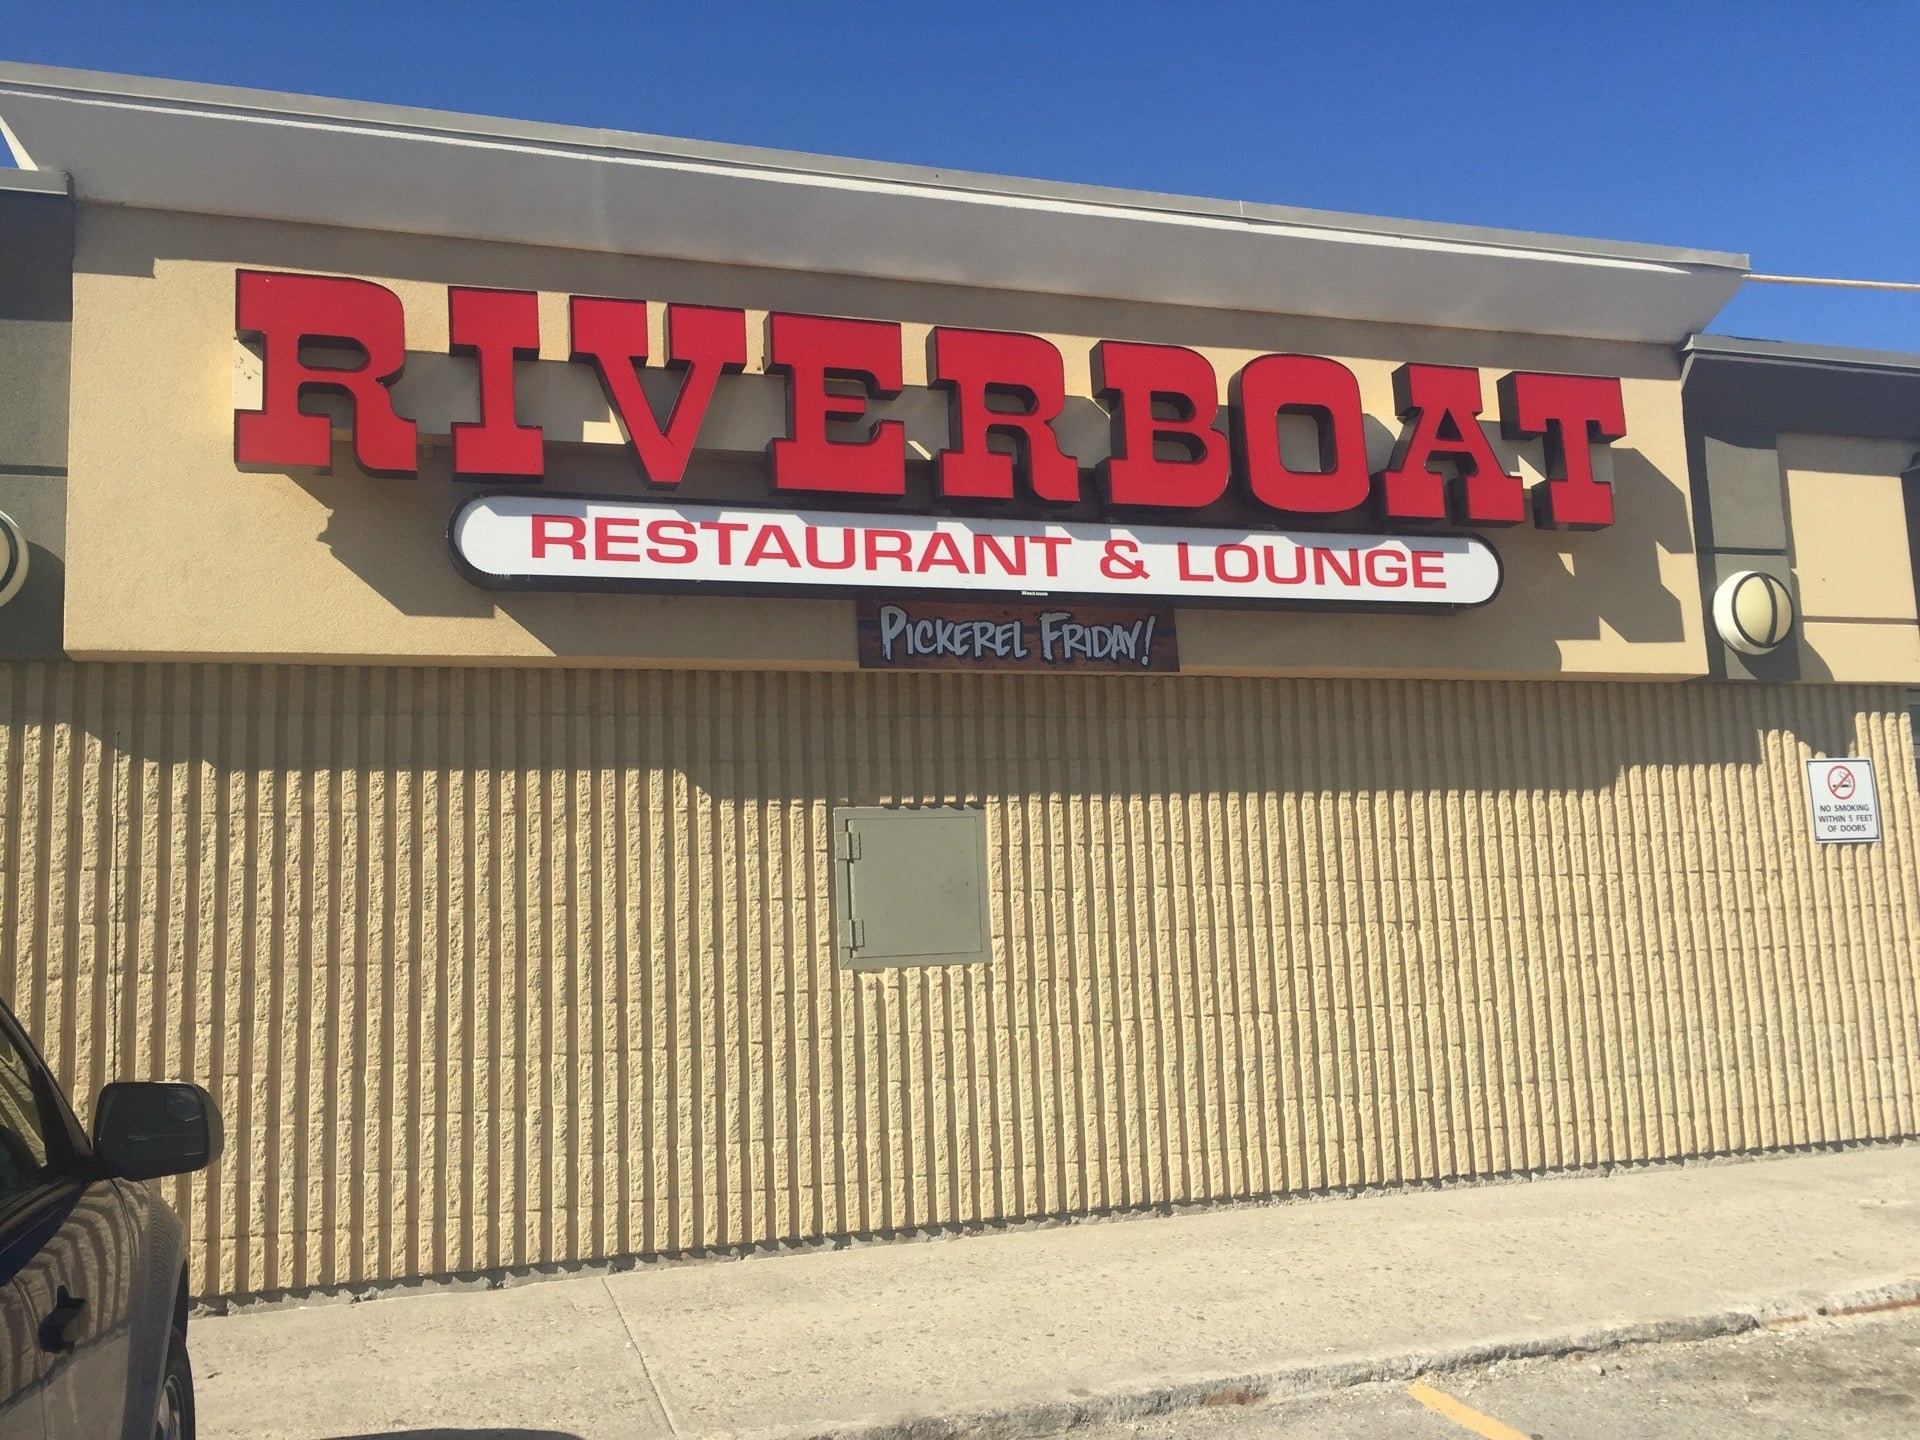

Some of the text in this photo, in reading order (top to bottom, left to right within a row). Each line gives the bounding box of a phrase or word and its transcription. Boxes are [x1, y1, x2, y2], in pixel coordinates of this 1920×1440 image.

[234, 268, 1627, 526] RIVERBOAT
[530, 514, 1447, 589] RESTAURANT & LOUNGE
[880, 605, 1156, 666] PICKEREL FRIDAY!
[1818, 815, 1846, 823] WITHIN
[1856, 814, 1873, 822] FEET
[1819, 804, 1869, 813] NO SMOKING
[1840, 824, 1866, 832] DOORS
